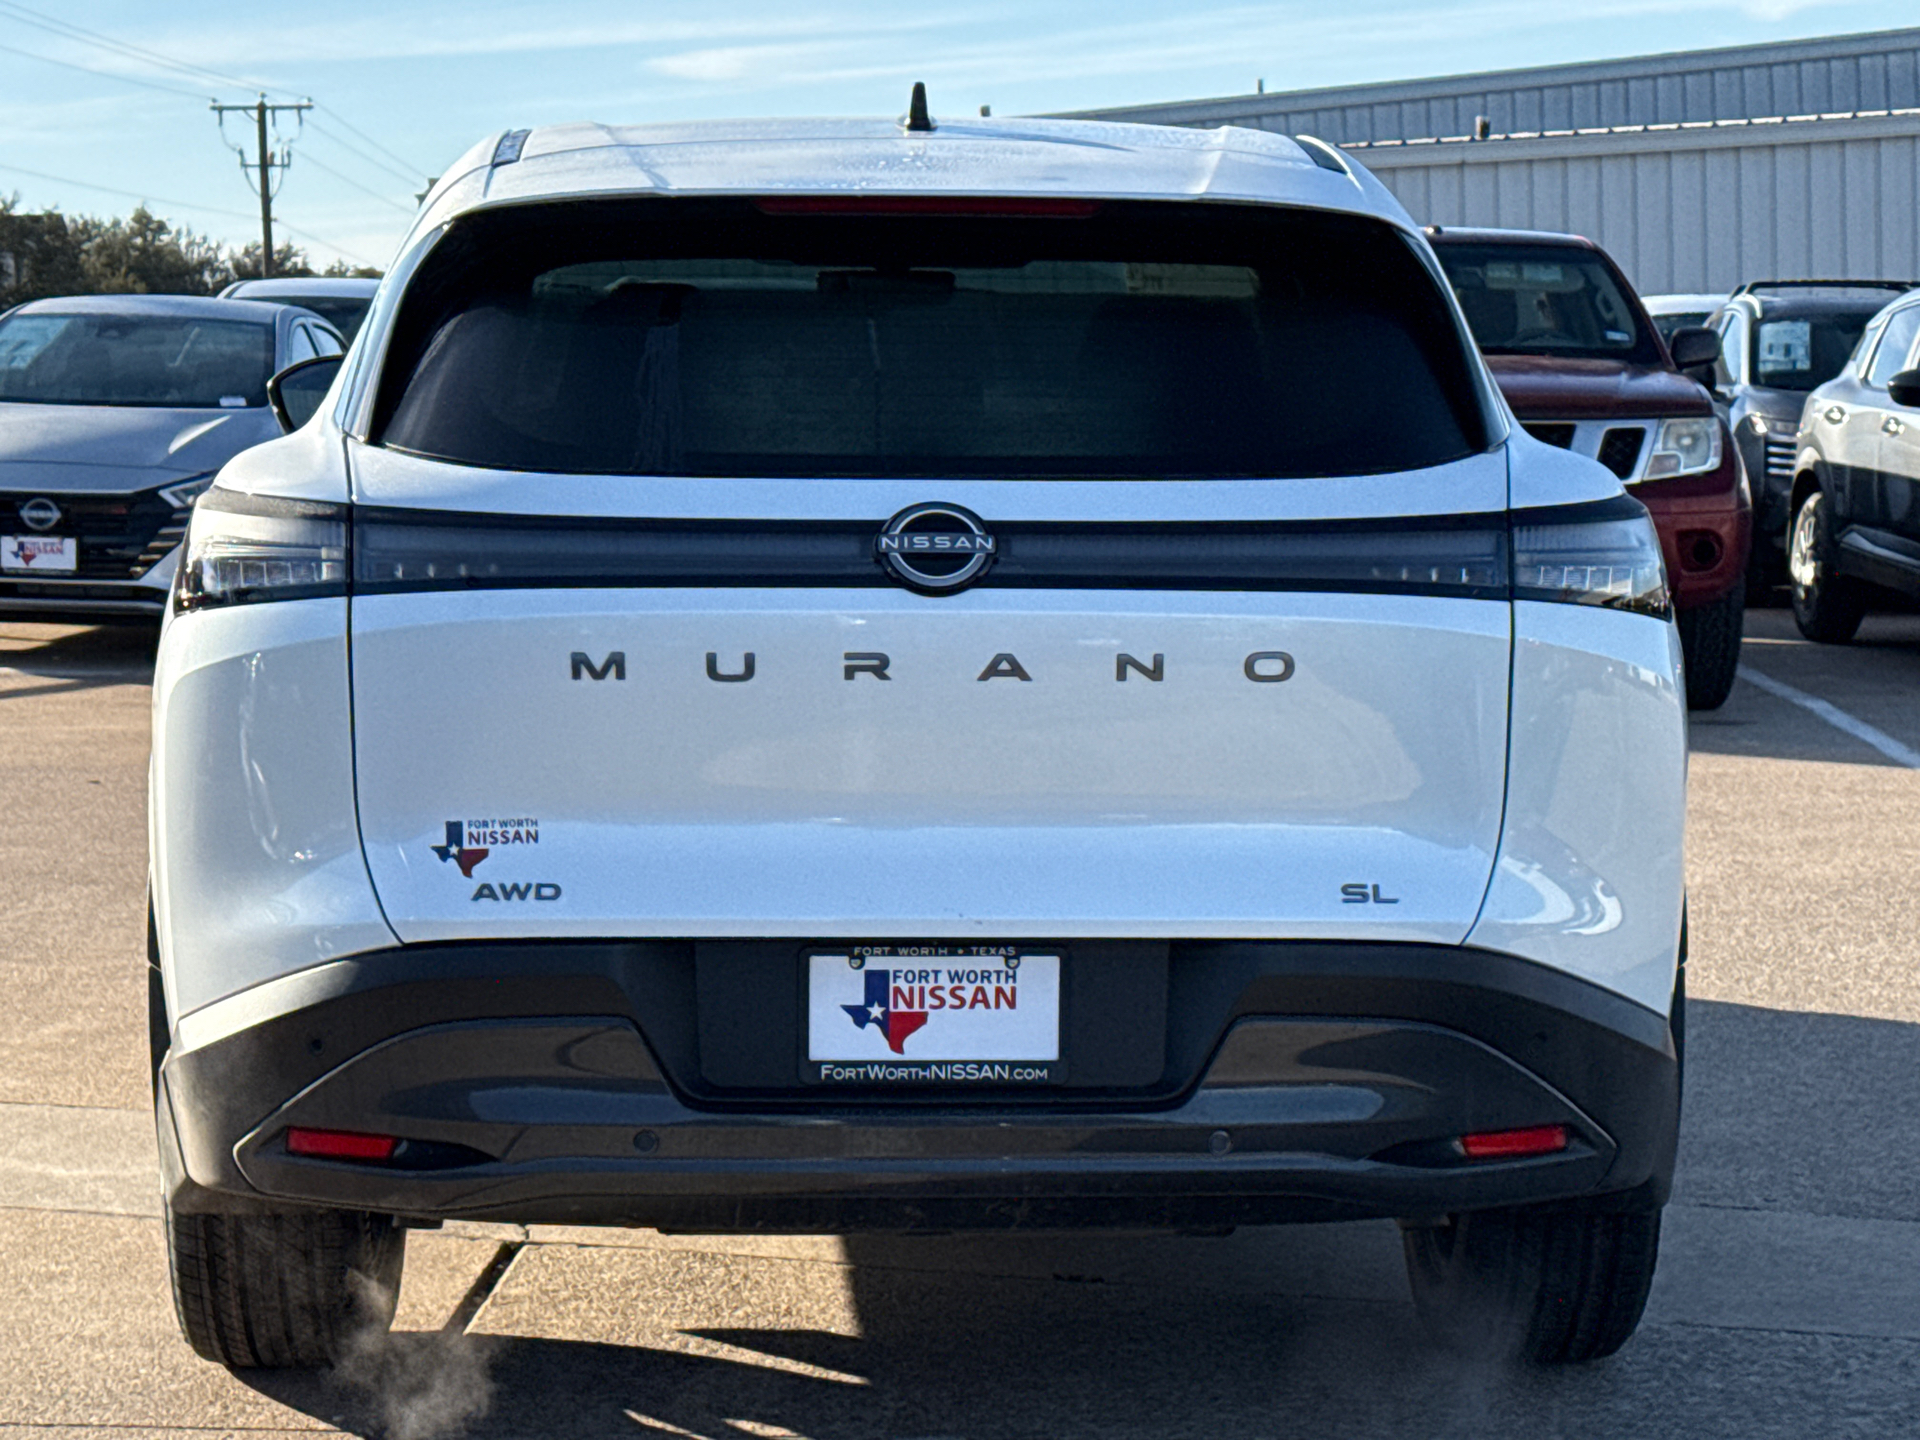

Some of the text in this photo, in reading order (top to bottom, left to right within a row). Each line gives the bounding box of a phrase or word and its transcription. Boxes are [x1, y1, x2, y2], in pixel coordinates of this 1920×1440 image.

[881, 536, 993, 550] NISSAN
[570, 651, 1296, 683] MURANO
[467, 818, 539, 830] FORT WORTH
[468, 829, 539, 846] NISSAN
[470, 882, 562, 902] AWD
[1341, 883, 1400, 904] SL
[853, 947, 1016, 956] FORT WORTH TEXAS
[892, 969, 1017, 984] FORT WORTH
[892, 985, 1017, 1010] NISSAN
